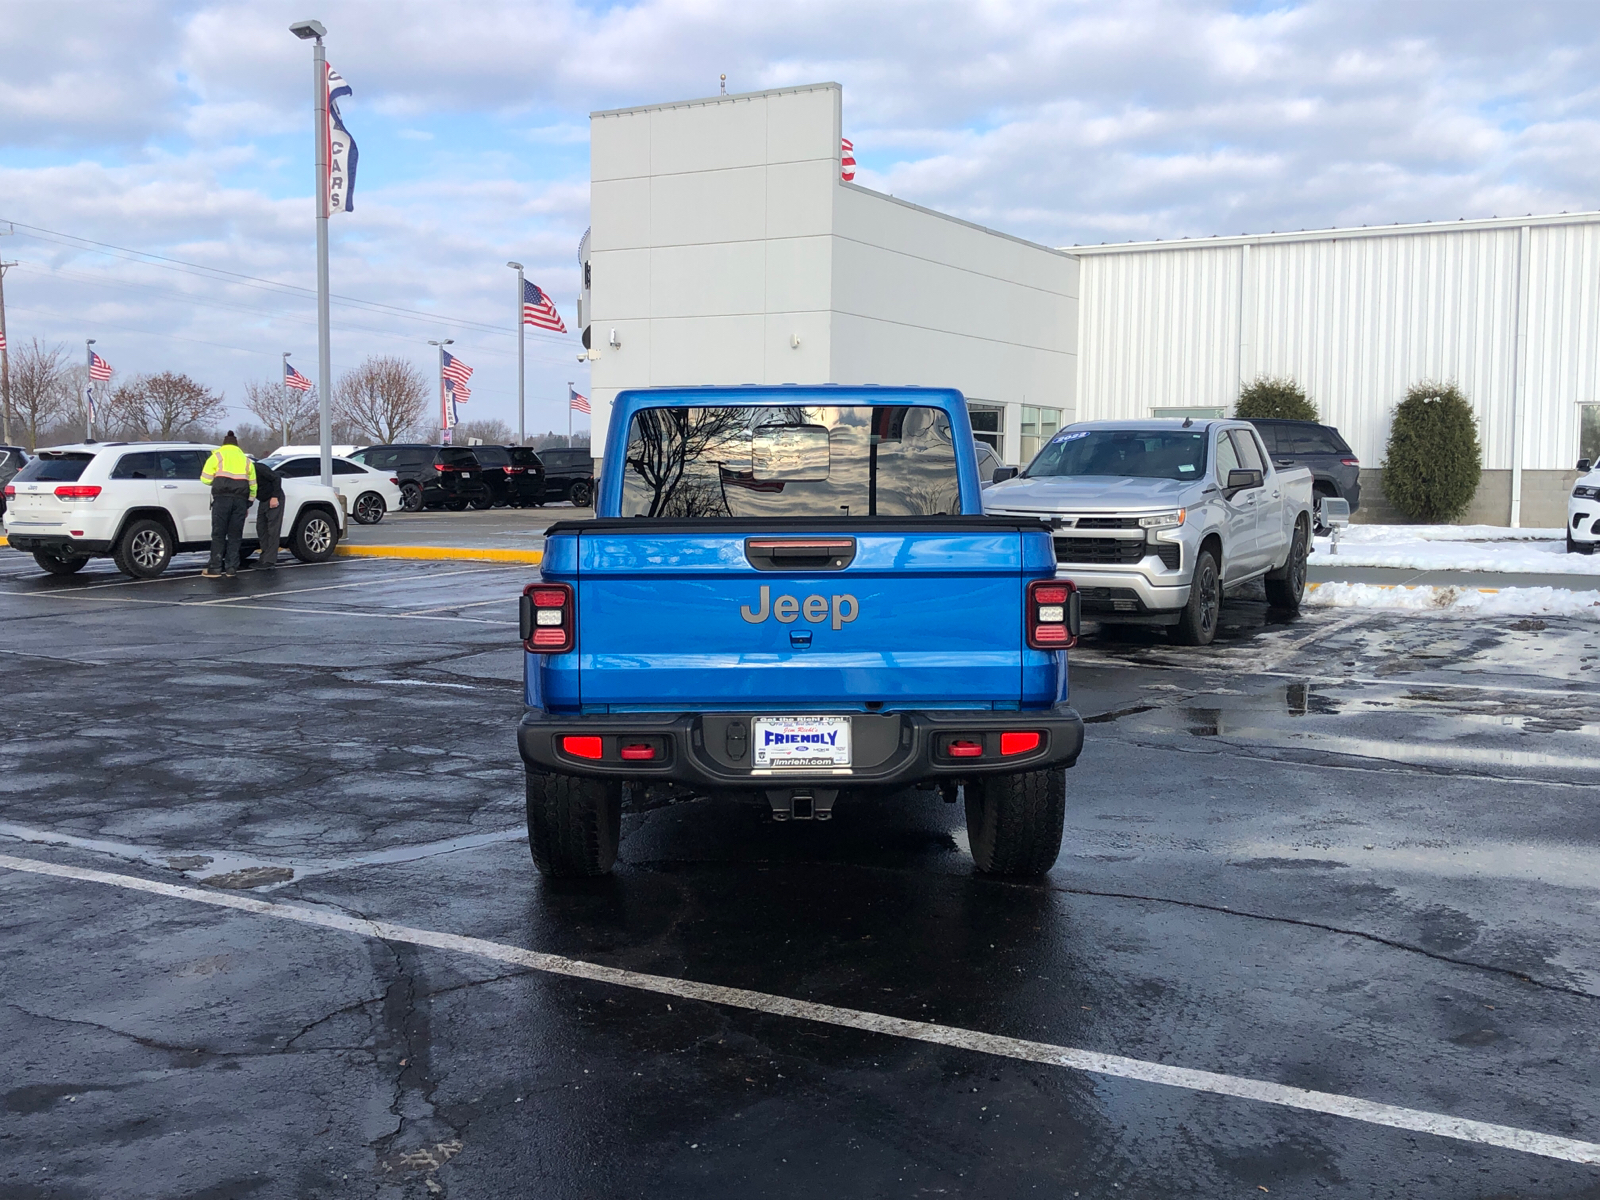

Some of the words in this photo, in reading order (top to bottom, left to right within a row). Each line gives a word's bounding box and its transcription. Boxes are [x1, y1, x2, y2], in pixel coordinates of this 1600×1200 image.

[331, 141, 344, 207] CARS
[740, 585, 859, 631] Jeep
[764, 730, 838, 746] FRIENDLY
